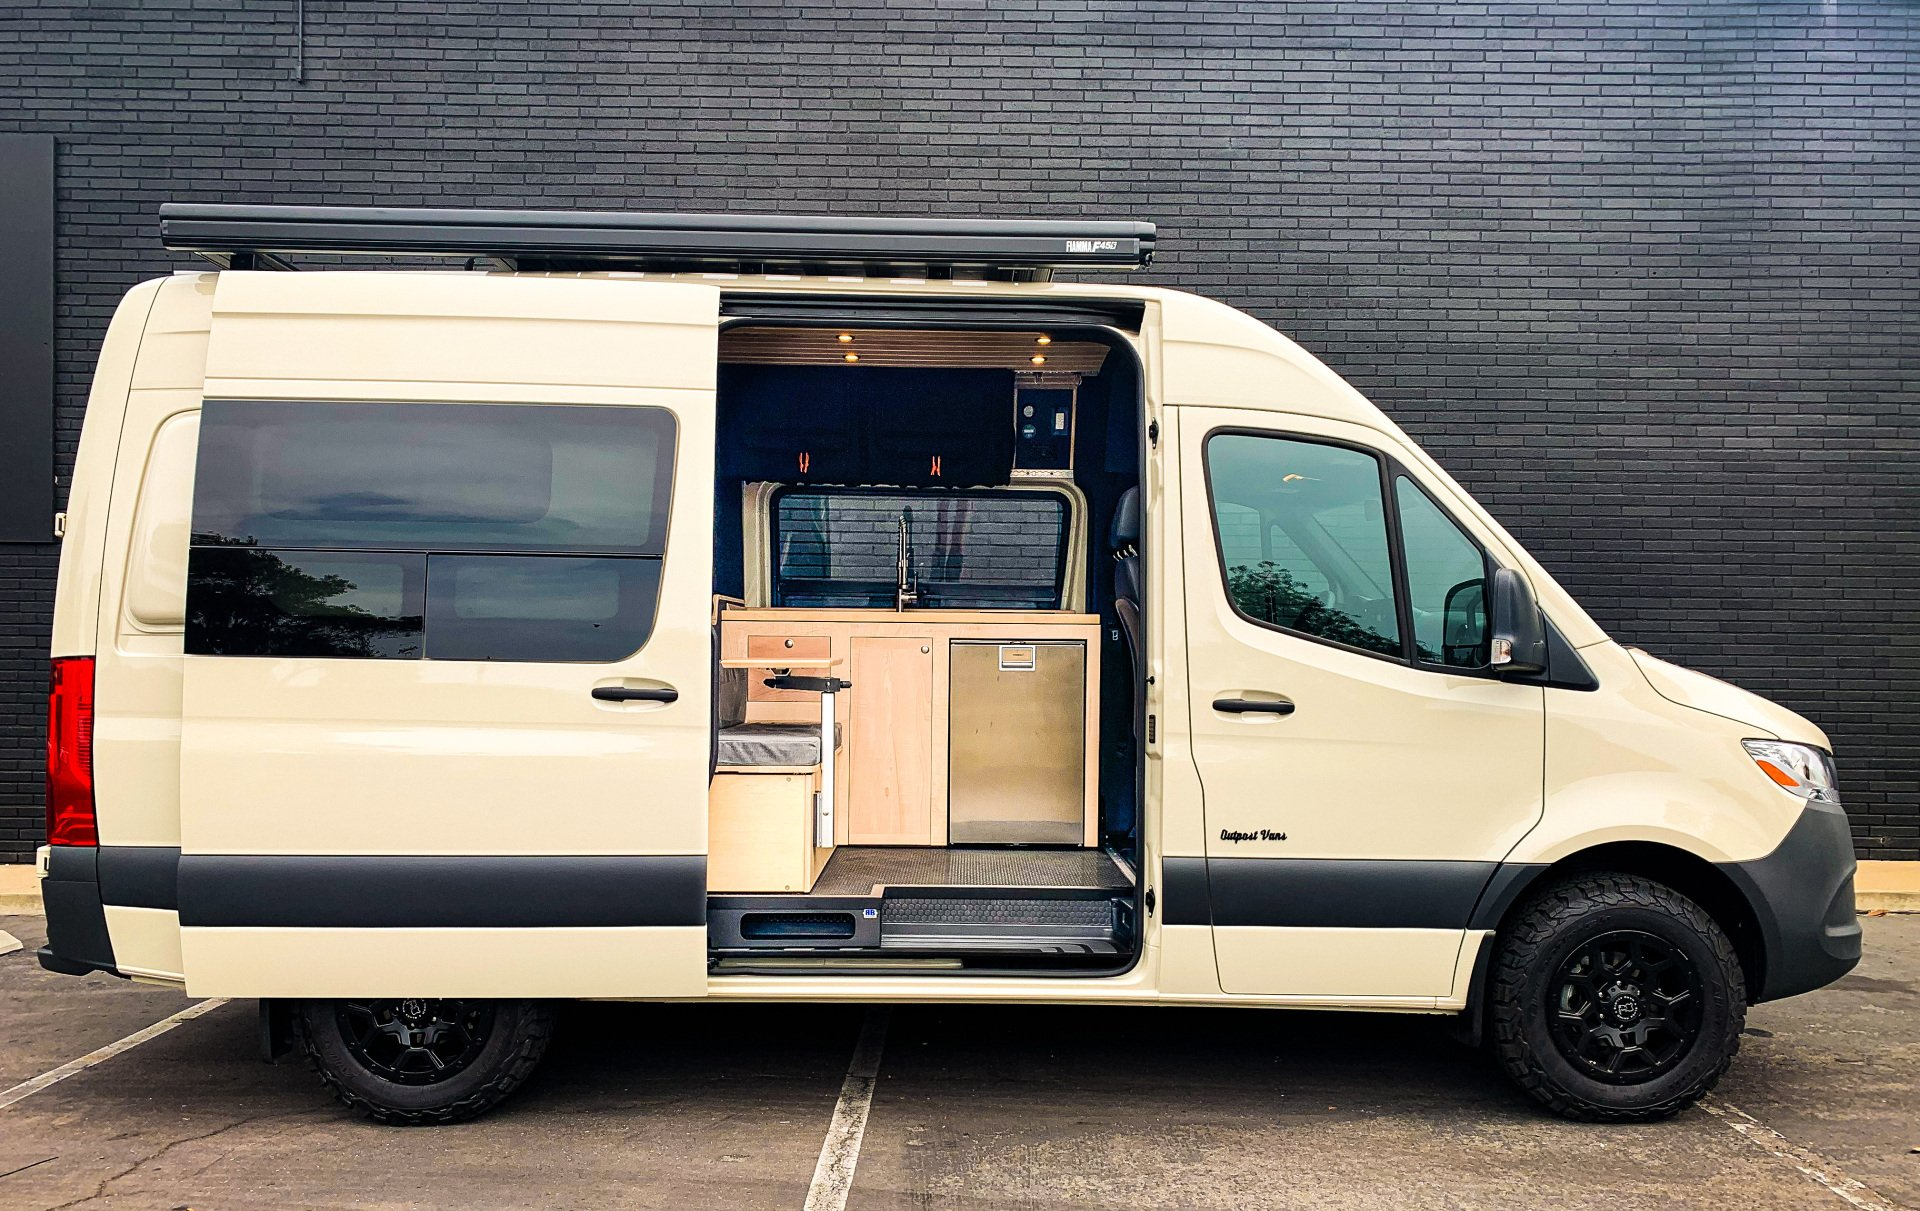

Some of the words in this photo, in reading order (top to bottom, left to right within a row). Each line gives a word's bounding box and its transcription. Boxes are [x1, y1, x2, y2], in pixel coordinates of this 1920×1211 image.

[1066, 241, 1091, 252] FIAMMA
[1220, 829, 1258, 844] Outpost
[1260, 829, 1287, 840] Vans
